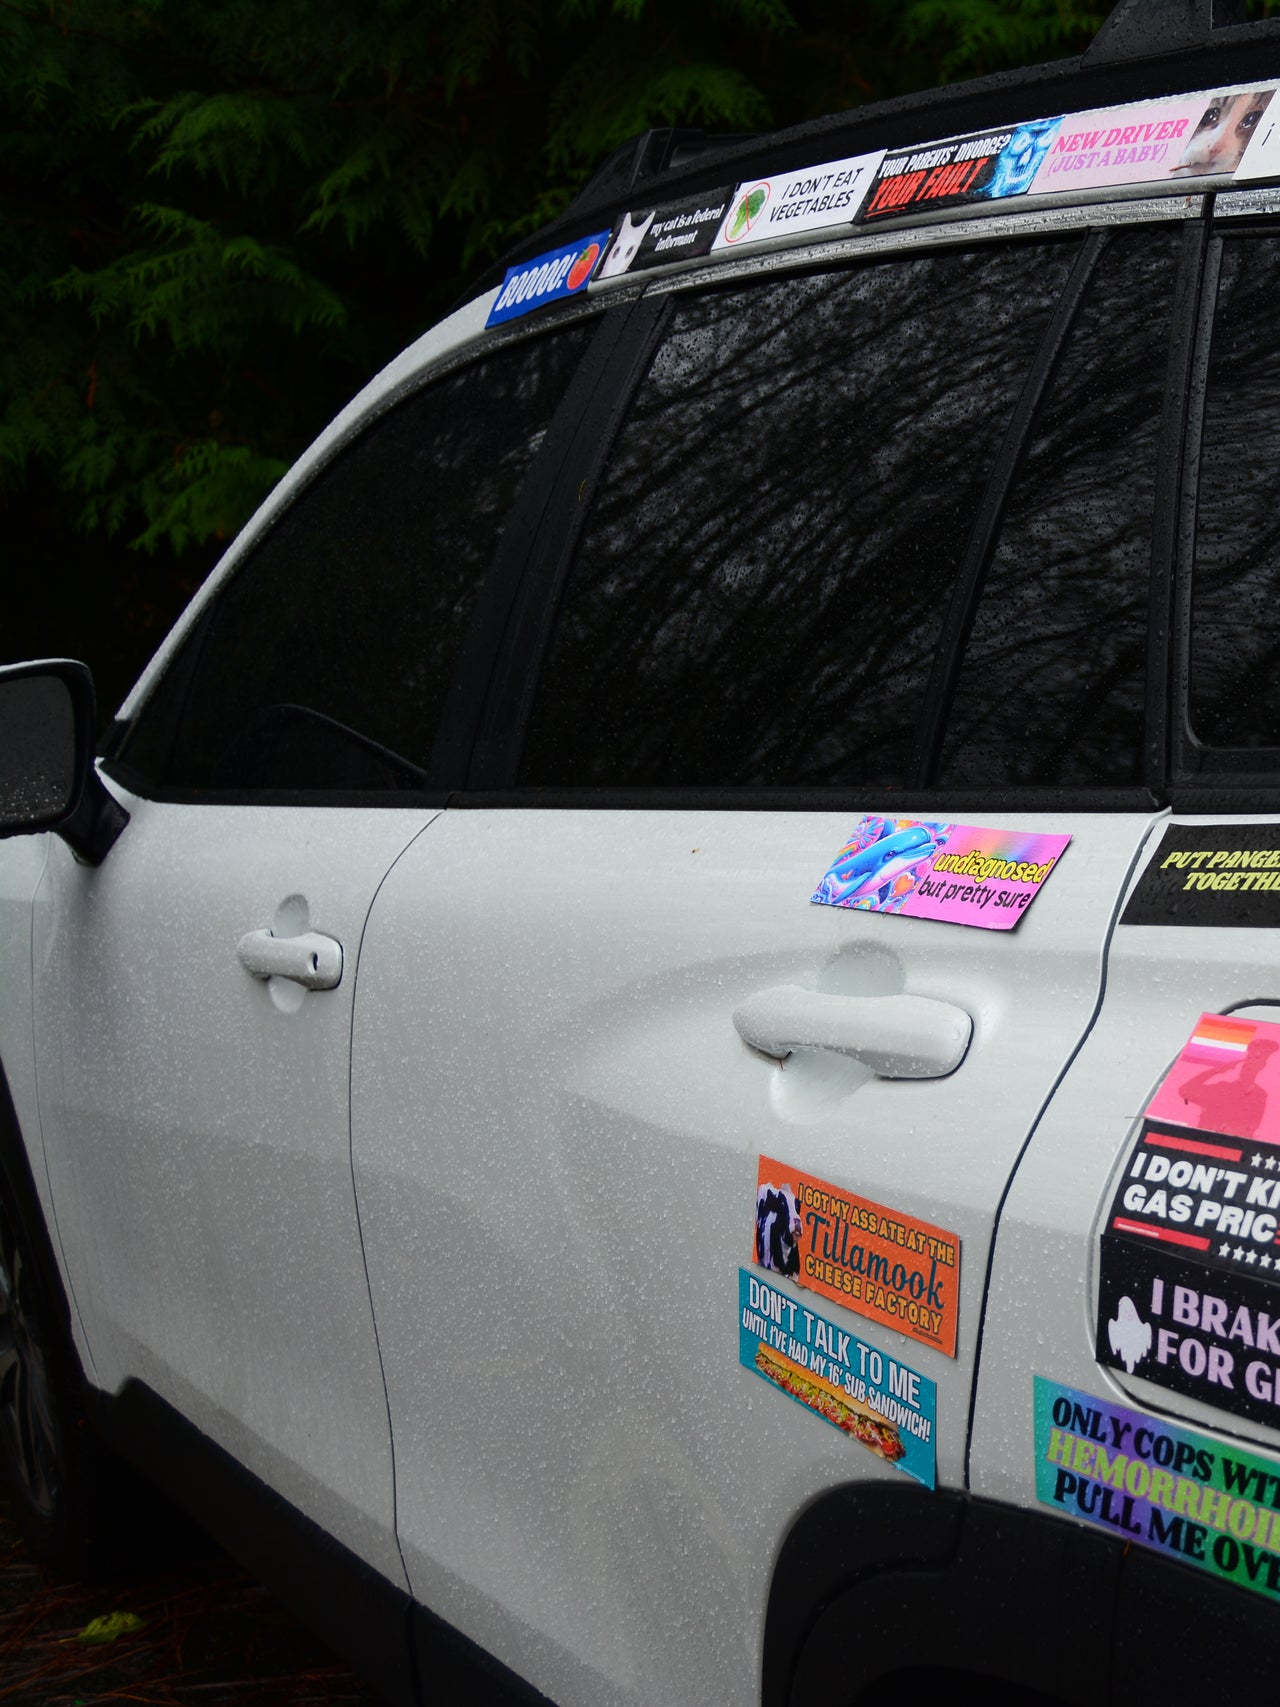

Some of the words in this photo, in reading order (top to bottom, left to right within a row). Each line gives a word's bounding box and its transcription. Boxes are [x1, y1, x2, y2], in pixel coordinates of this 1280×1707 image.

[1051, 130, 1106, 154] NEW
[1101, 119, 1189, 147] DRIVER
[1261, 122, 1276, 148] i
[878, 156, 909, 178] YOUR
[904, 145, 958, 173] PARENTS'
[953, 134, 1011, 162] DIVORCE?
[1047, 152, 1100, 176] (JUST
[1096, 150, 1111, 167] A
[1112, 143, 1168, 166] BABY)
[782, 184, 791, 199] I
[789, 174, 834, 198] DON'T
[832, 167, 864, 189] EAT
[867, 170, 928, 211] YOUR
[915, 157, 989, 202] FAULT
[650, 222, 665, 238] my
[663, 217, 679, 231] cat
[676, 214, 687, 228] is
[684, 215, 693, 226] a
[690, 204, 725, 225] federal
[770, 190, 855, 222] VEGETABLES
[654, 230, 698, 251] informant
[495, 252, 578, 311] BOOOOO!
[933, 851, 1056, 884] undiagnosed
[1160, 851, 1210, 869] PUT
[918, 878, 945, 898] but
[942, 880, 995, 910] pretty
[994, 890, 1032, 909] sure
[1130, 1152, 1148, 1178] I
[1148, 1154, 1248, 1199] DON'T
[1123, 1184, 1196, 1223] GAS
[797, 1182, 805, 1204] I
[805, 1187, 829, 1211] GOT
[830, 1199, 850, 1222] MY
[850, 1204, 878, 1235] ASS
[878, 1217, 906, 1246] ATE
[906, 1230, 926, 1254] AT
[926, 1236, 955, 1267] THE
[806, 1211, 945, 1309] Tillamook
[805, 1254, 862, 1299] CHEESE
[865, 1282, 943, 1335] FACTORY
[1150, 1278, 1165, 1315] I
[750, 1277, 798, 1332] DON'T
[803, 1310, 851, 1367] TALK
[856, 1342, 883, 1385] TO
[889, 1361, 922, 1409] ME
[1157, 1328, 1236, 1389] FOR
[742, 1307, 768, 1342] UNTIL
[769, 1324, 787, 1354] I'VE
[788, 1336, 808, 1368] HAD
[810, 1351, 828, 1378] MY
[844, 1370, 867, 1403] SUB
[867, 1386, 931, 1443] SANDWICH!
[1052, 1397, 1132, 1449] ONLY
[1133, 1426, 1215, 1482] COPS
[1053, 1467, 1141, 1535] PULL
[1147, 1507, 1209, 1561] ME
